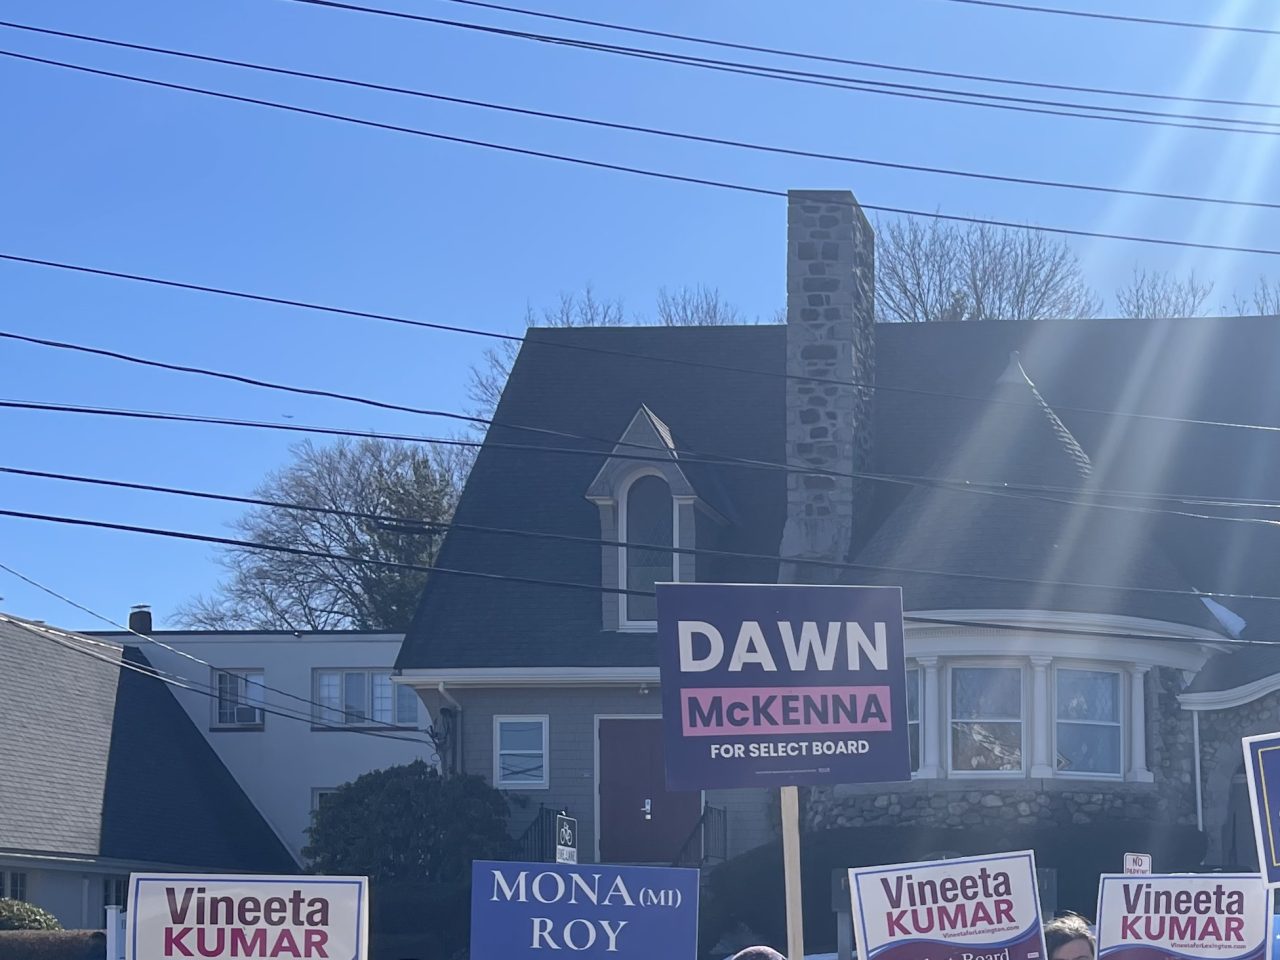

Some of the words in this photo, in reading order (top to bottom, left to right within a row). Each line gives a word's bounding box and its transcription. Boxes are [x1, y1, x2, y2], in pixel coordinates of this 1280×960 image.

[677, 620, 888, 672] DAWN
[687, 693, 887, 728] McKENNA
[710, 743, 746, 759] FOR
[749, 741, 808, 758] SELECT
[812, 740, 870, 756] BOARD
[1132, 857, 1143, 867] NO
[489, 870, 636, 907] MONA
[639, 887, 682, 908] (MI)
[880, 867, 1013, 909] Vineeta
[1122, 883, 1245, 915] Vineeta
[165, 887, 329, 927] Vineeta
[885, 898, 1017, 937] KUMAR
[164, 927, 330, 959] KUMAR
[529, 917, 629, 952] ROY
[1121, 915, 1245, 941] KUMAR
